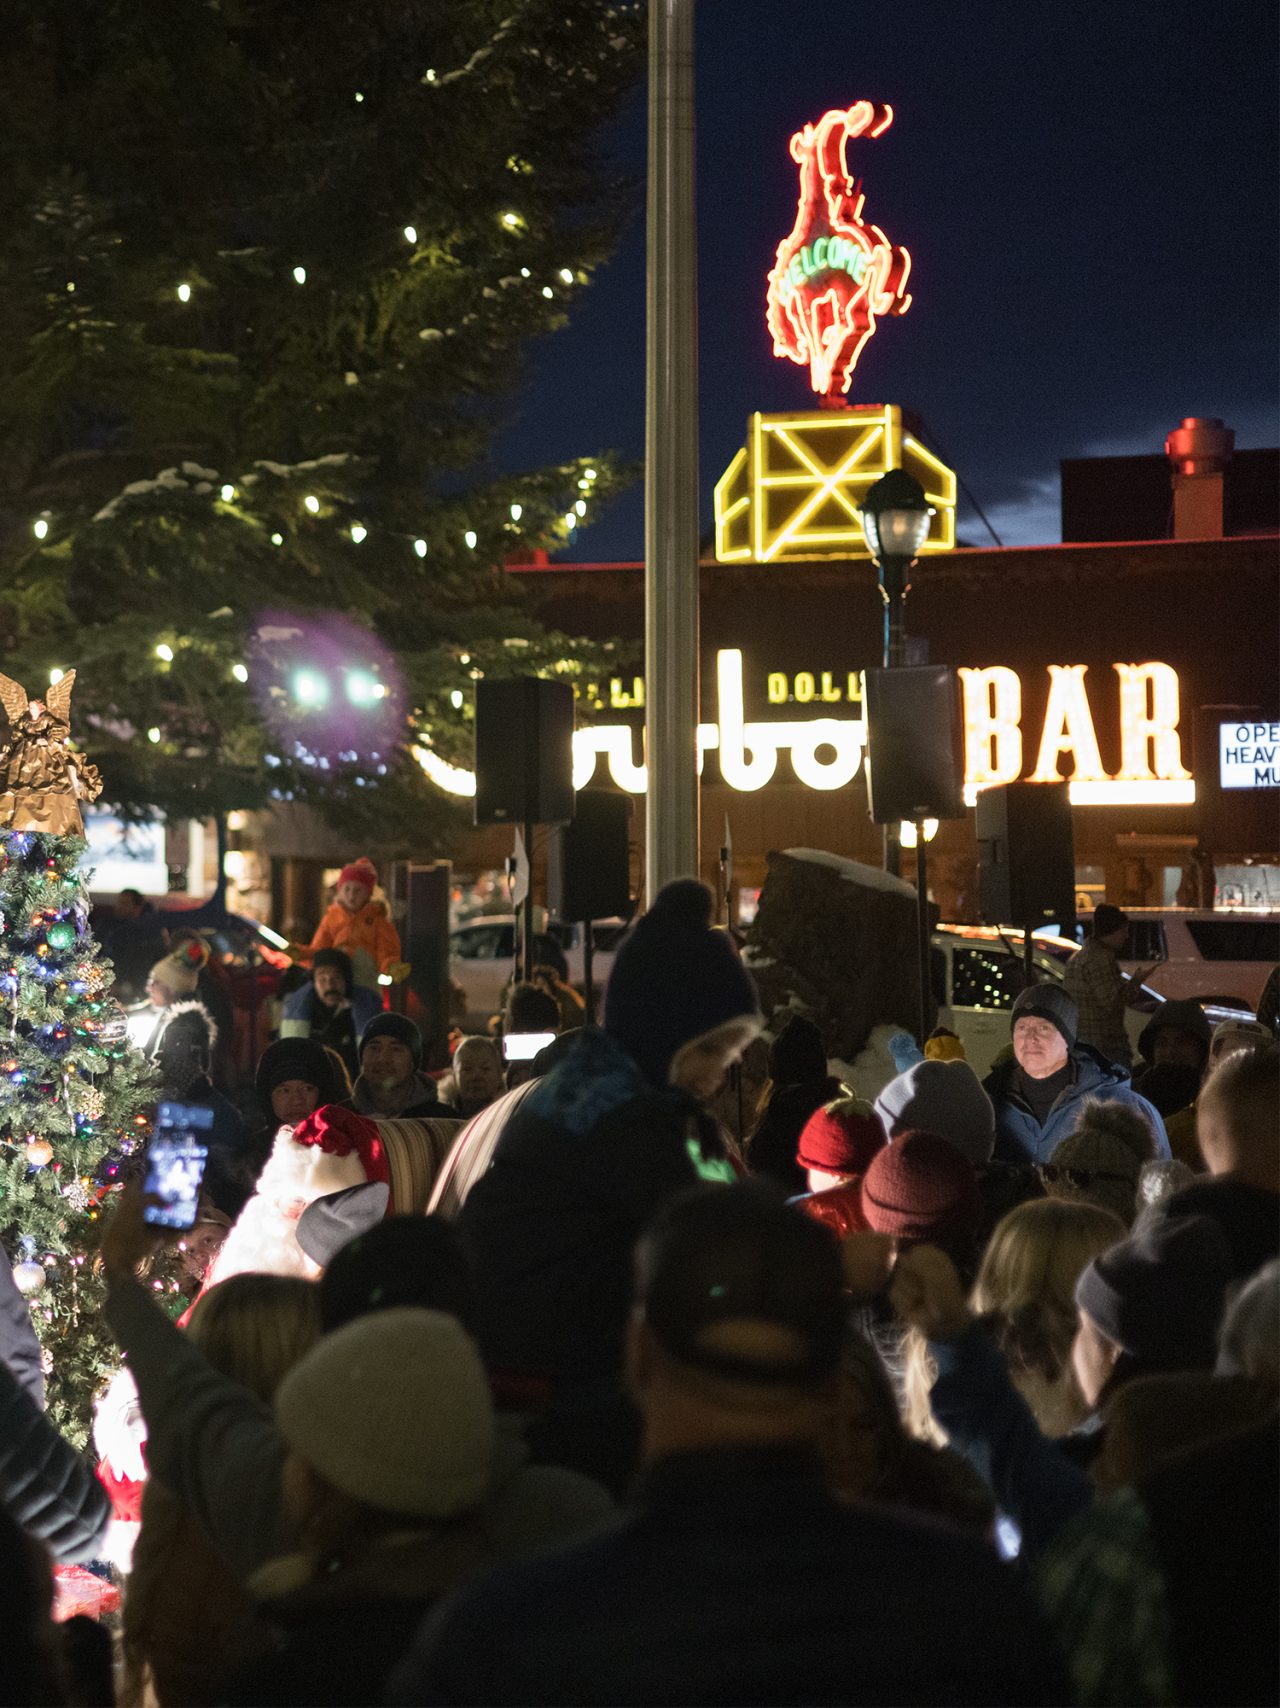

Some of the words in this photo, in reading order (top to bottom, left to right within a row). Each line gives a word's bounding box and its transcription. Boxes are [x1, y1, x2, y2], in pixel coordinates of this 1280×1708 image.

[767, 671, 862, 703] DOLL
[957, 661, 1193, 783] BAR
[1235, 725, 1280, 743] OPE
[1226, 746, 1280, 764] HEAV
[1254, 766, 1280, 785] MU
